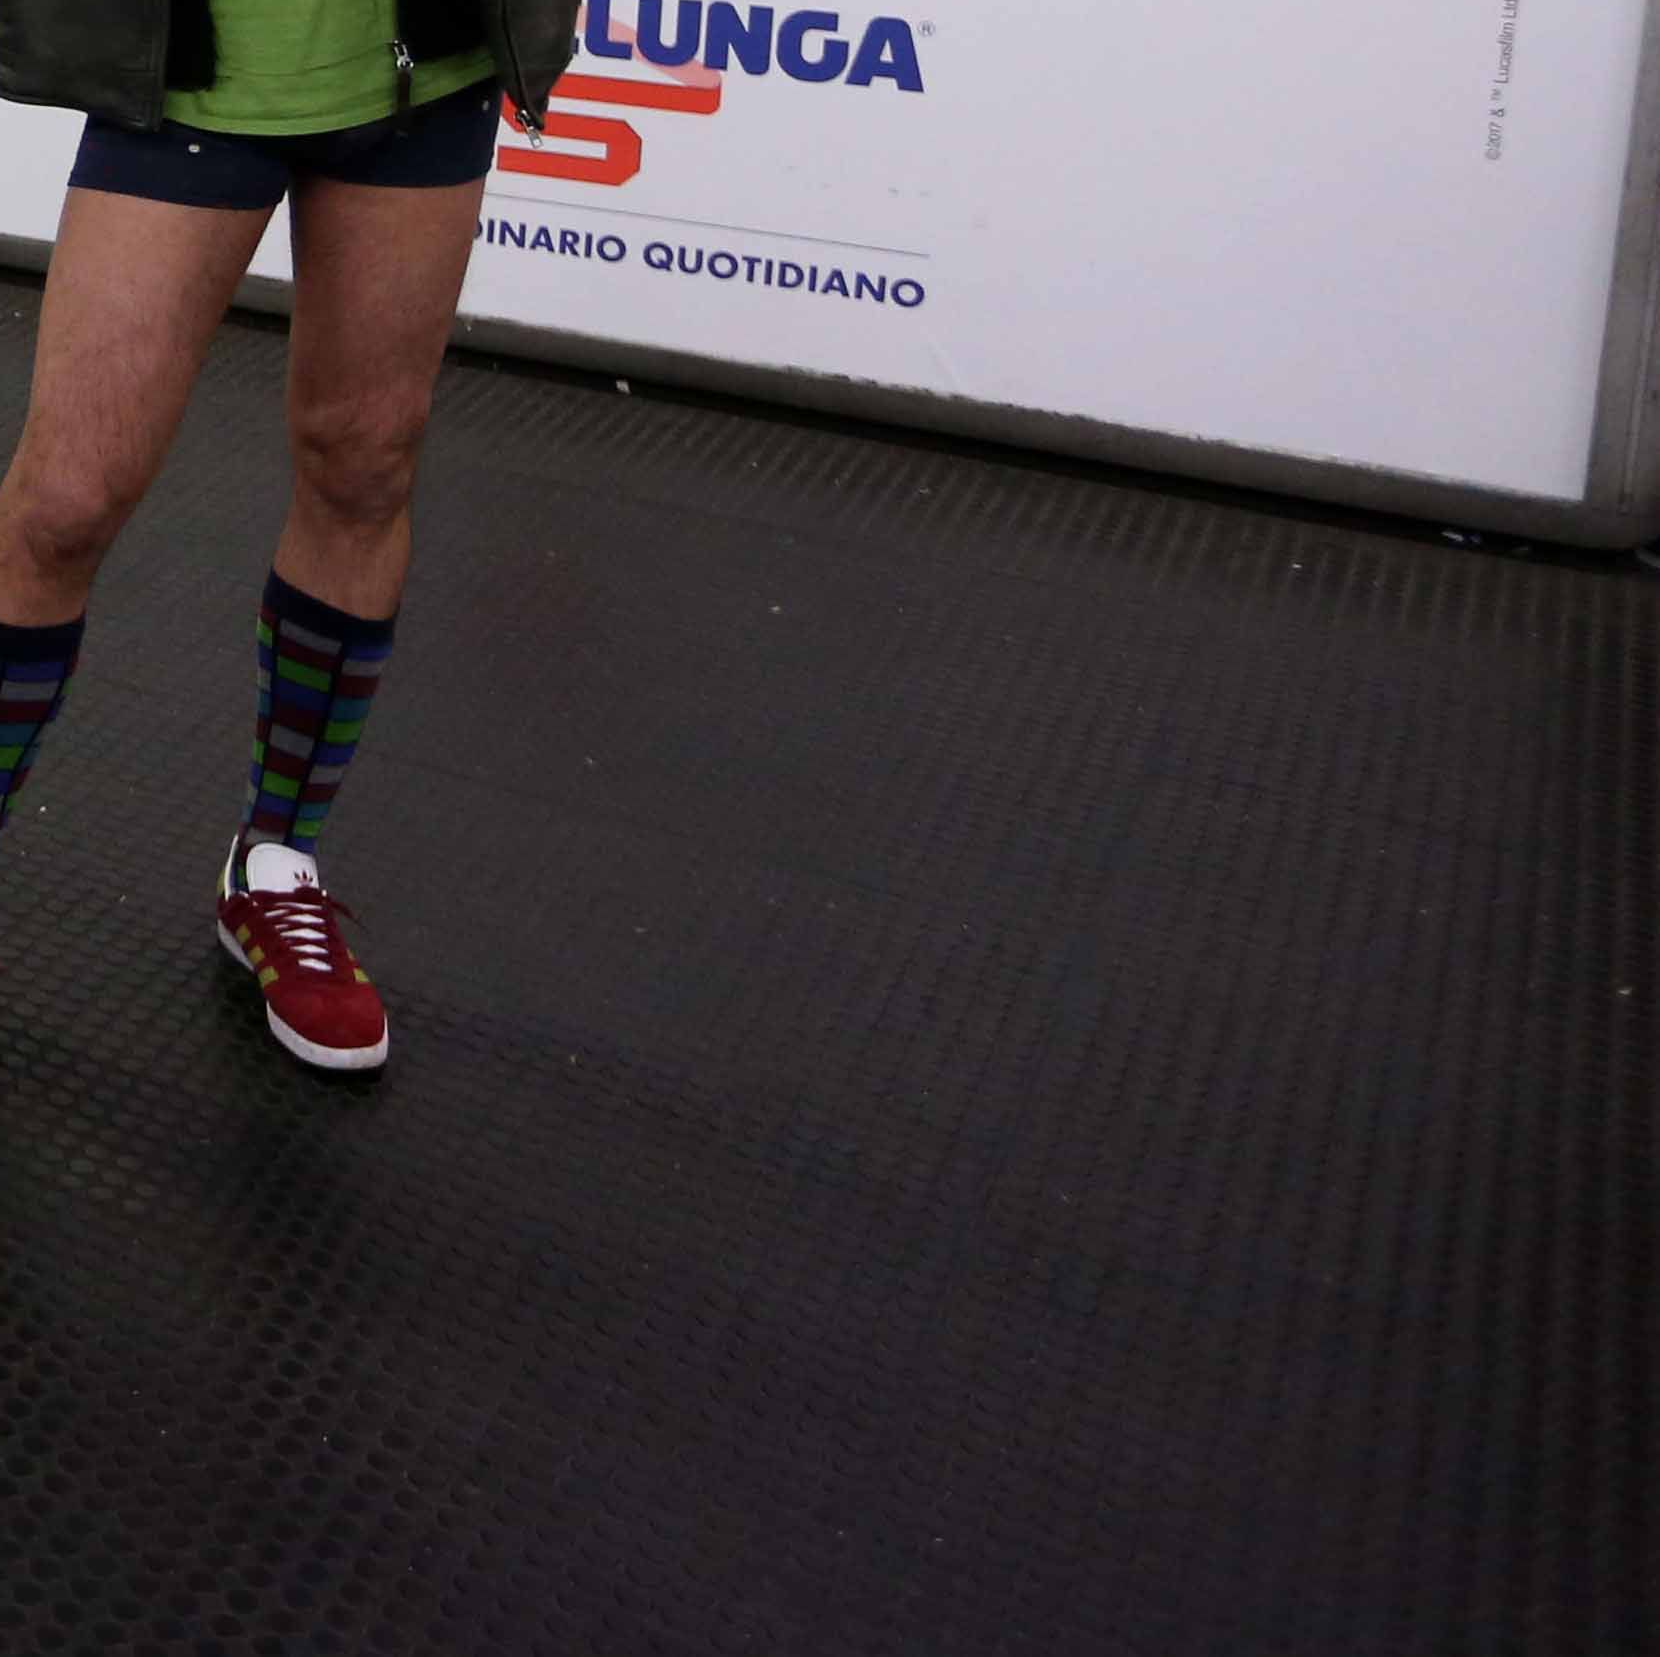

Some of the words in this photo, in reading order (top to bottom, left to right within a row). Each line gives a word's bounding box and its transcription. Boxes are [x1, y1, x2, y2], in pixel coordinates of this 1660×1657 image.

[1493, 21, 1515, 84] Lucasfilm
[476, 217, 627, 263] INARIO
[643, 241, 925, 307] QUOTIDIANO
